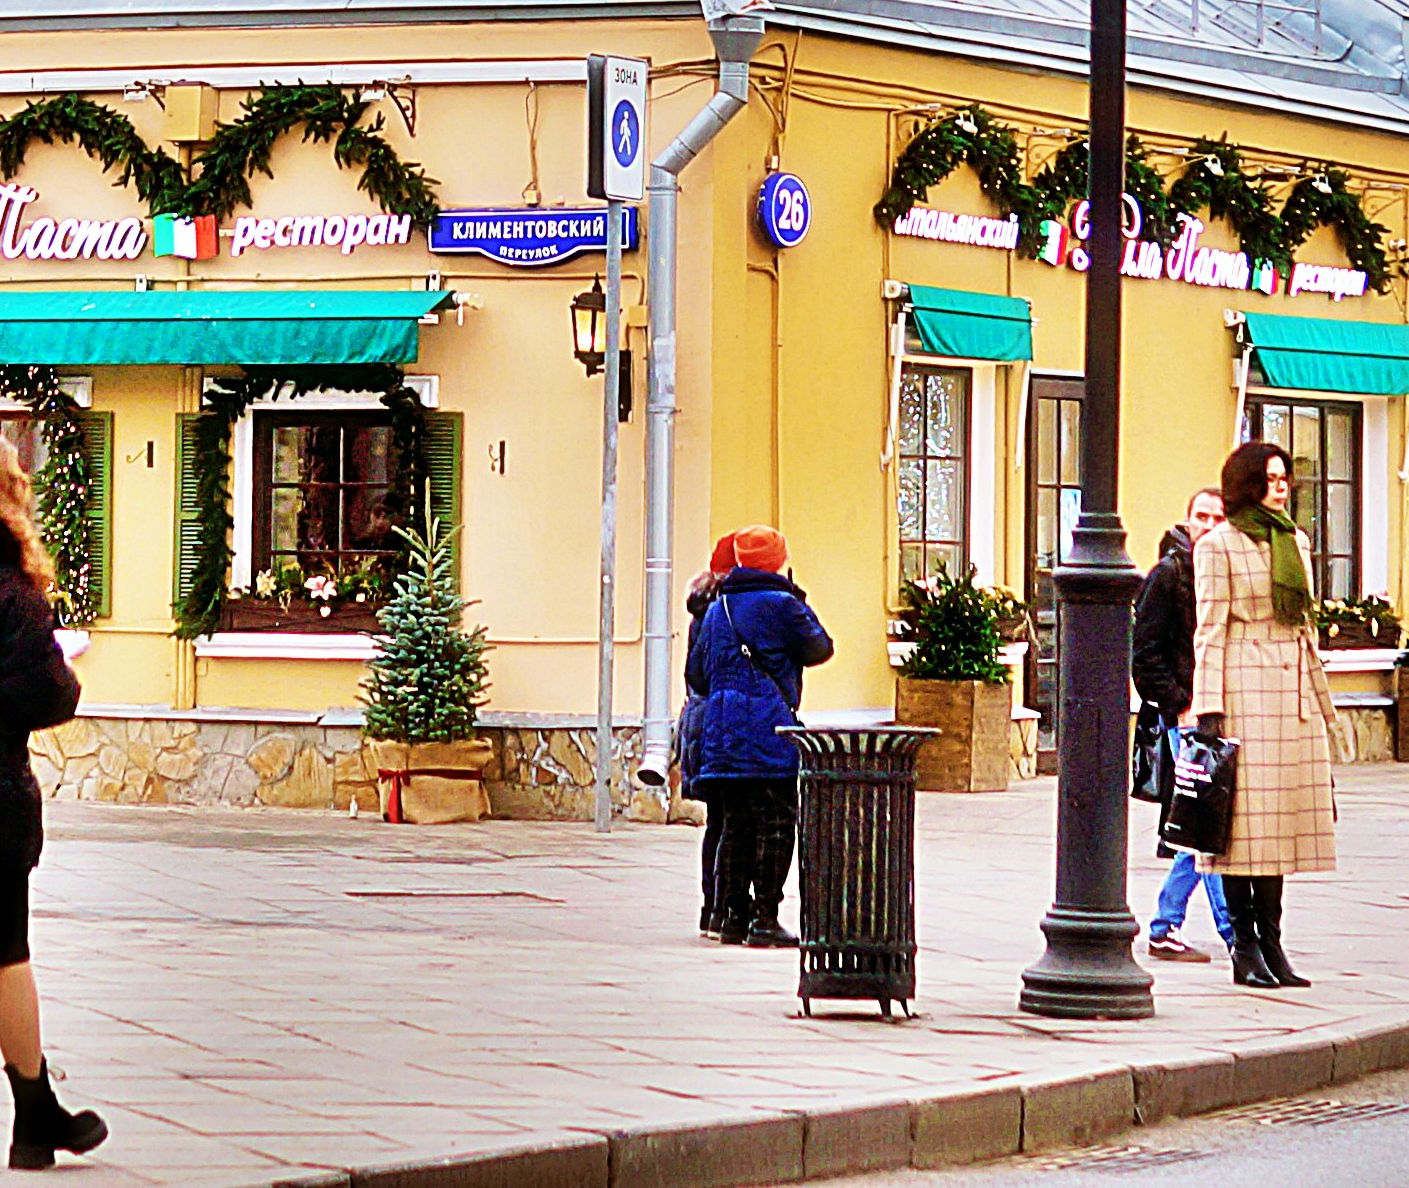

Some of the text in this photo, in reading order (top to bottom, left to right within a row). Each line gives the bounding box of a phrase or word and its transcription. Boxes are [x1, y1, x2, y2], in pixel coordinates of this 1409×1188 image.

[614, 68, 638, 85] ЗОНА
[778, 188, 804, 231] 26
[231, 213, 413, 257] ресторан
[452, 216, 604, 240] КЛИМЕНТОВСКИЙ
[499, 244, 559, 260] ПЕРЕУЛОК
[894, 207, 1019, 251] итальянский
[1166, 212, 1251, 291] Паста
[1288, 262, 1368, 302] ресторан
